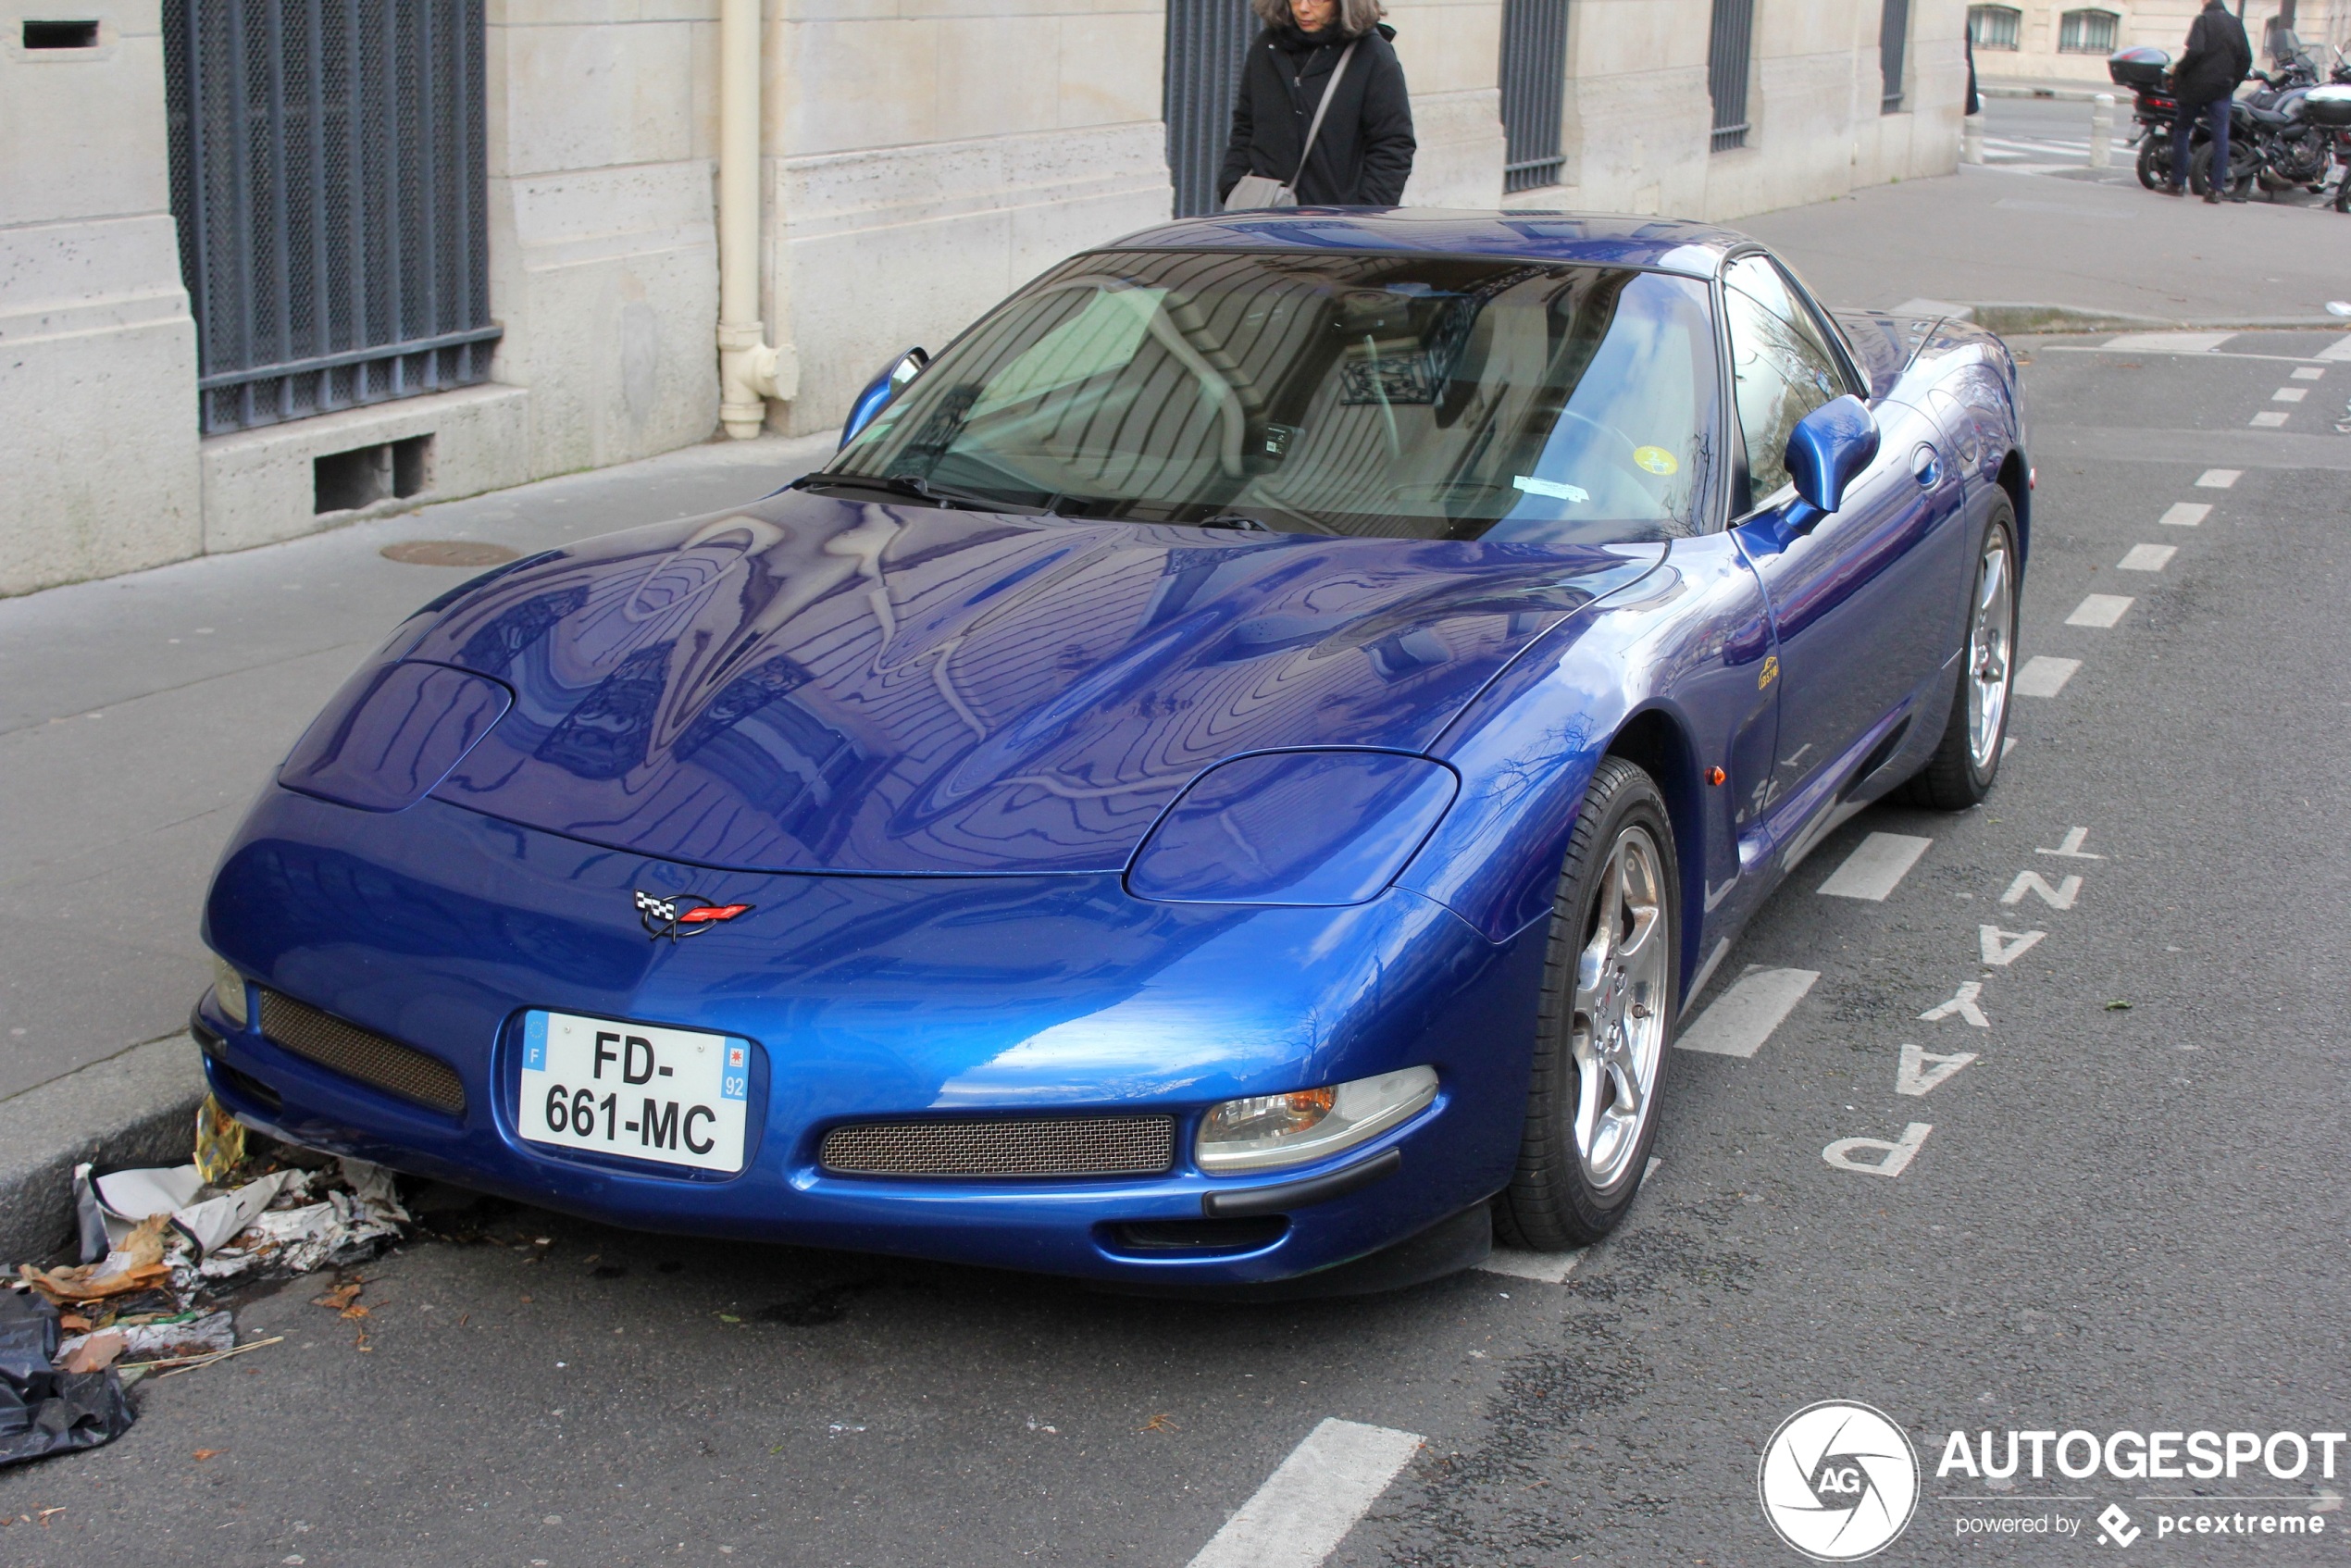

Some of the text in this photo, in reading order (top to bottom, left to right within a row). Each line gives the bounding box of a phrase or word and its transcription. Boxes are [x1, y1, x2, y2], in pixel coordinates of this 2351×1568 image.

[1822, 827, 2108, 1177] PAYANT
[529, 1048, 540, 1063] F
[593, 1031, 674, 1085] FD-
[725, 1076, 744, 1097] 92
[545, 1084, 716, 1155] 661-MC
